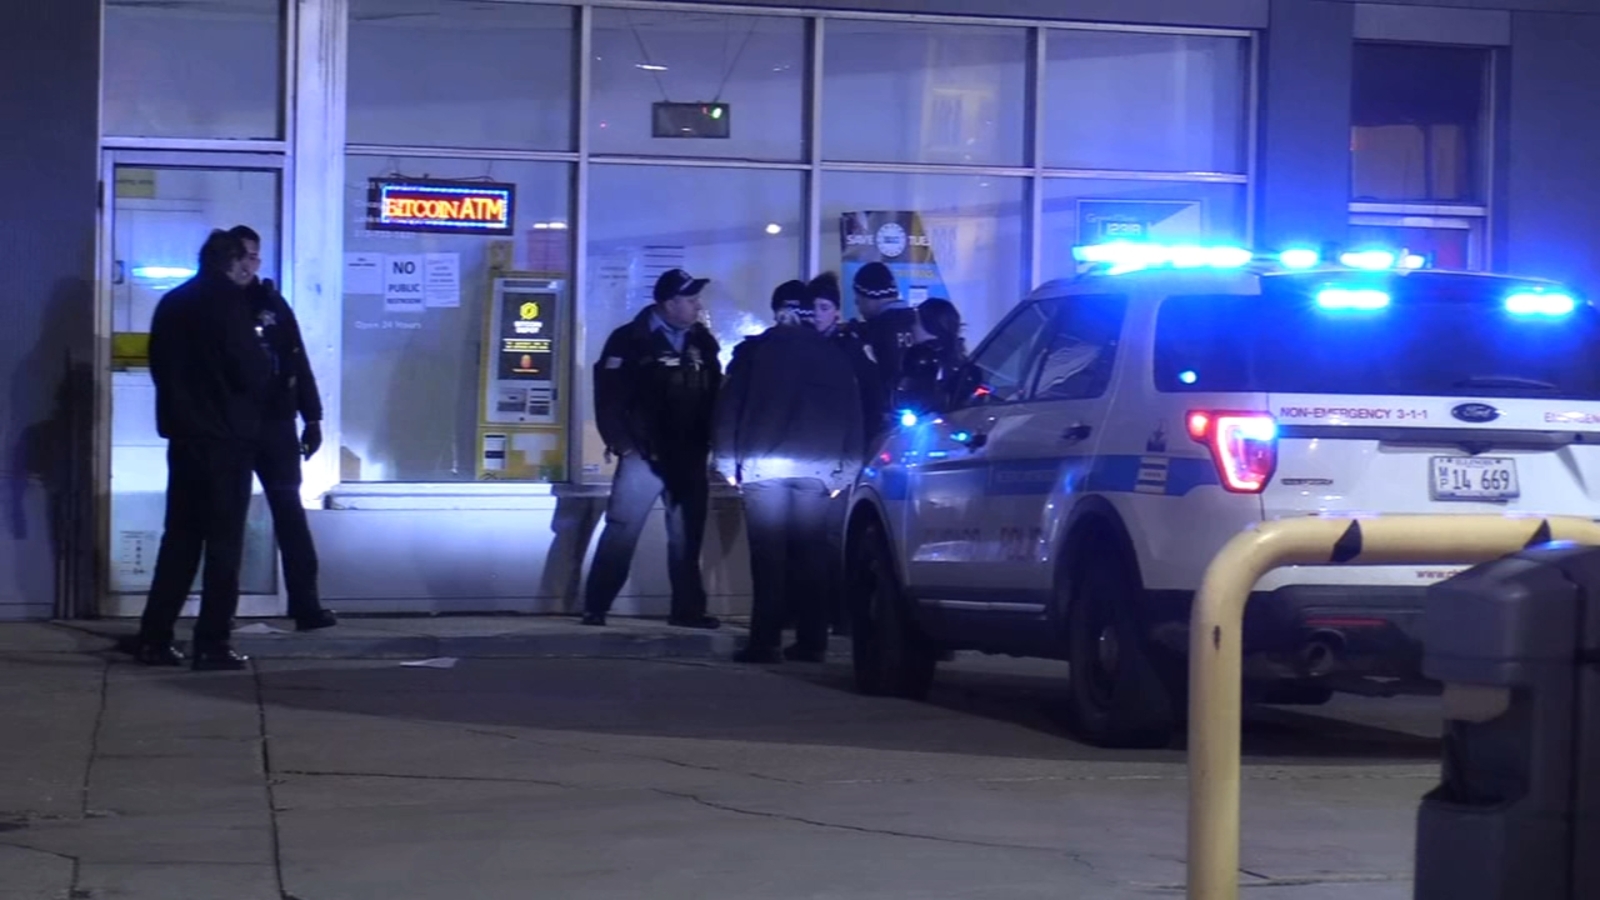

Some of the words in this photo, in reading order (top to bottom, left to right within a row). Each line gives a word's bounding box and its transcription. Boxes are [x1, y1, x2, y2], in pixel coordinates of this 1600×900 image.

[385, 198, 460, 218] BITCOIN
[459, 197, 503, 221] ATM
[846, 234, 874, 246] SAVE
[393, 261, 416, 275] NO
[388, 283, 420, 293] PUBLIC
[1280, 406, 1393, 420] NON-EMERGENCY
[1396, 408, 1429, 420] 3-1-1
[1453, 469, 1472, 491] 14
[1481, 469, 1510, 491] 669
